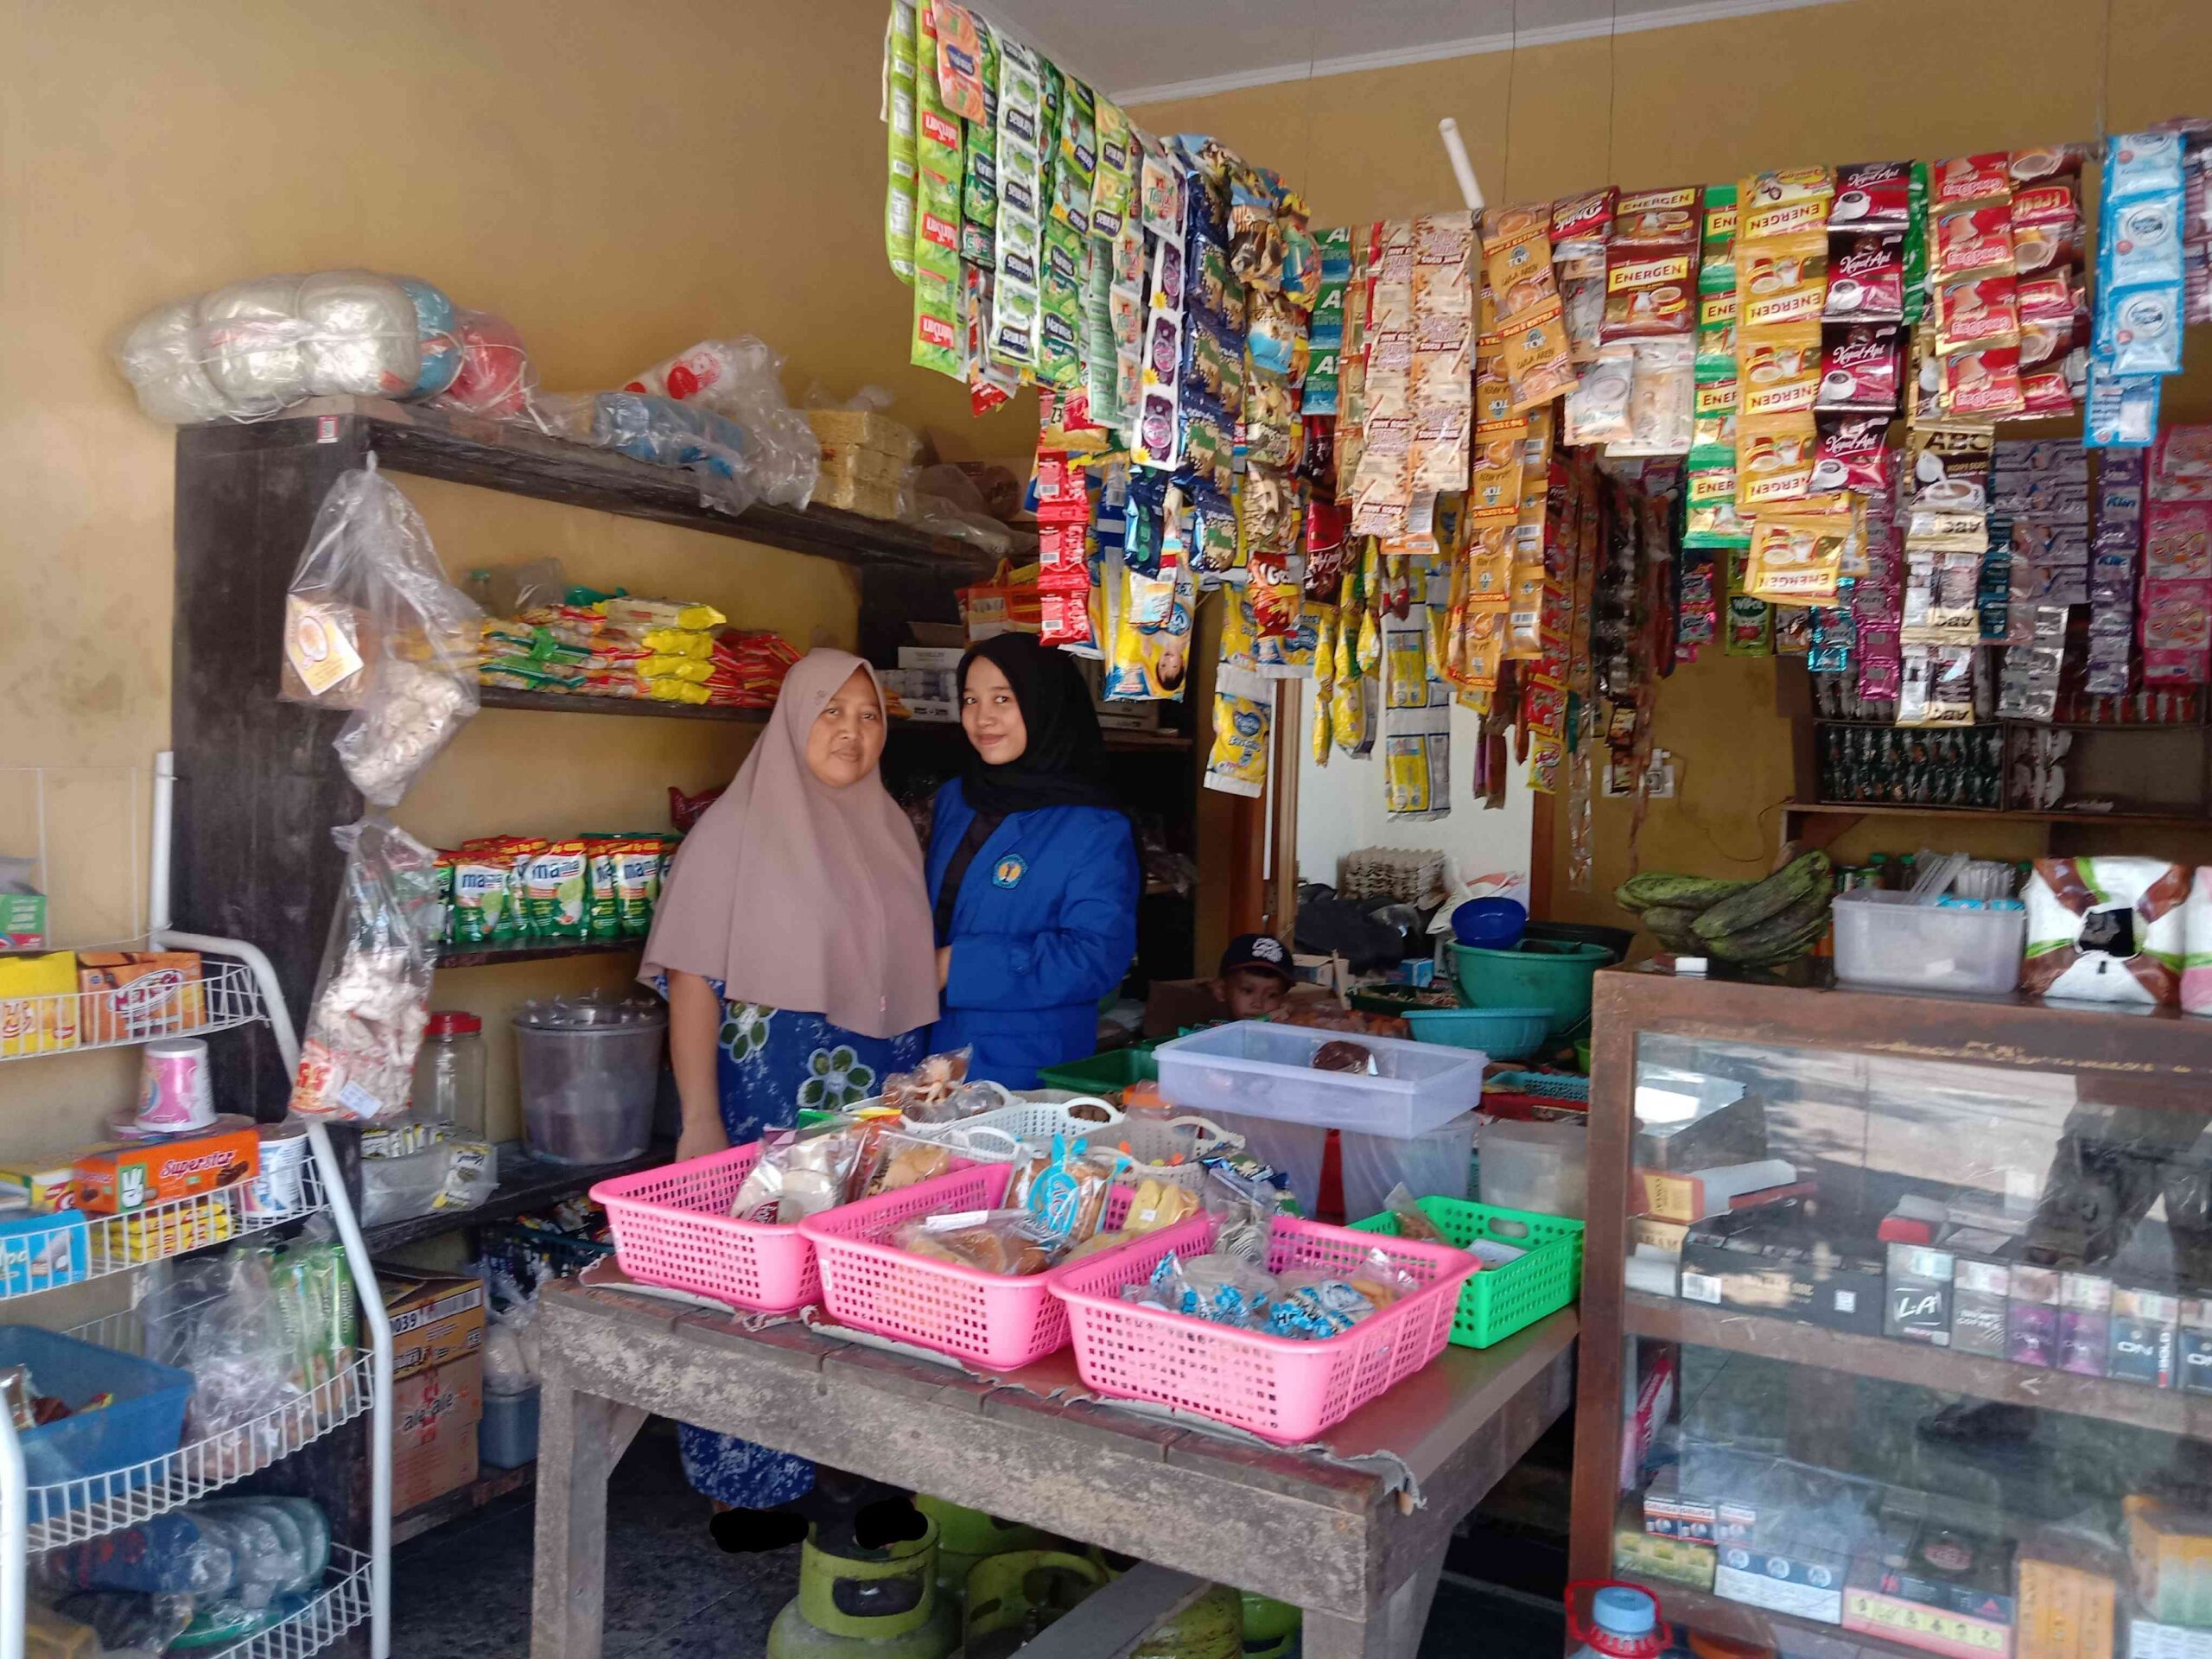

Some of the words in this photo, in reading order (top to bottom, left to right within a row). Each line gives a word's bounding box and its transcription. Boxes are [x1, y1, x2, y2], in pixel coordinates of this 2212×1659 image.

[1623, 193, 1690, 210] ENERGEN
[1555, 200, 1602, 232] Drink
[1751, 204, 1820, 229] ENERGEN
[1508, 255, 1530, 267] TOP
[1840, 256, 1869, 274] Kapal
[1870, 251, 1891, 267] Api
[1615, 264, 1681, 284] ENERGEN
[1751, 293, 1821, 317] ENERGEN
[1523, 337, 1546, 349] TOP
[1833, 345, 1862, 365] Kapal
[1862, 343, 1884, 359] Api
[1751, 384, 1820, 408] ENERGEN
[1856, 434, 1876, 448] Api
[1923, 431, 1991, 451] ABC
[160, 1150, 234, 1179] Superstar
